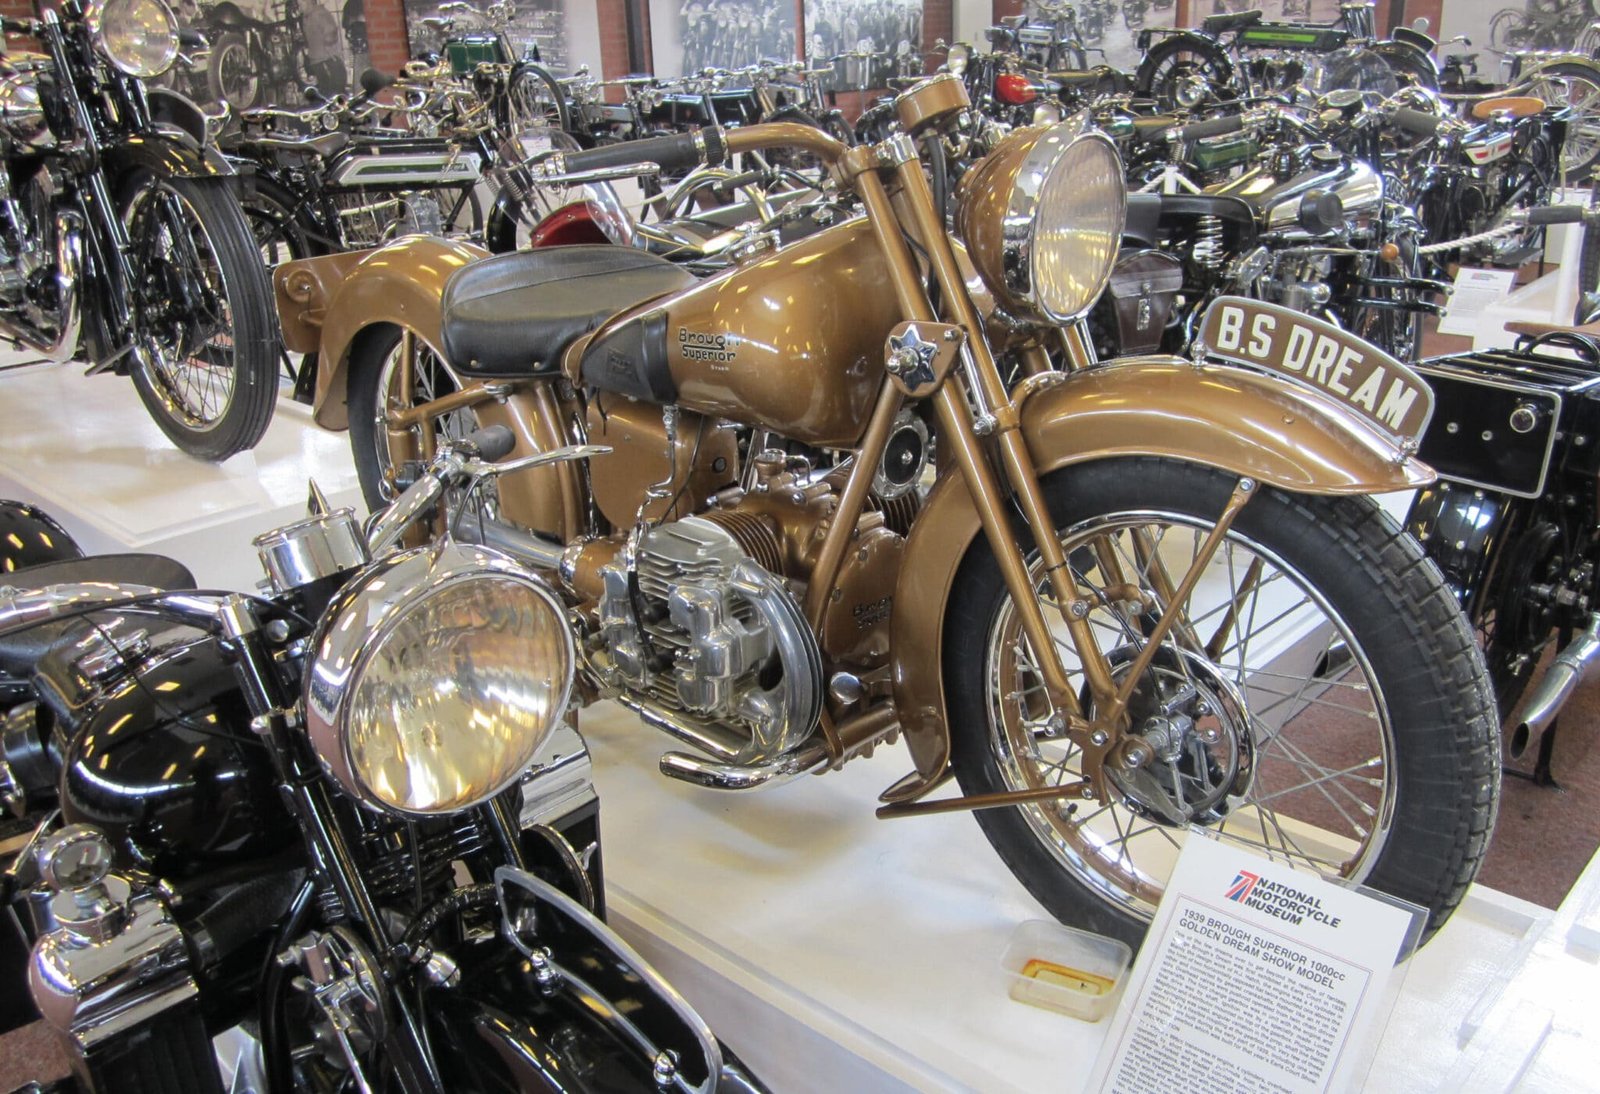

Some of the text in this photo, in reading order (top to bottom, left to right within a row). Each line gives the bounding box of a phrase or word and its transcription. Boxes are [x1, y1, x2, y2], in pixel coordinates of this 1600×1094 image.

[681, 345, 737, 362] Superior
[1217, 306, 1418, 430] B.S DREAM
[1244, 896, 1304, 926] MUSEUM
[1251, 886, 1342, 929] MOTORCYCLE
[1256, 876, 1322, 910] NATIONAL
[1178, 917, 1336, 989] GOLDEN DREAM SHOW MODEL
[1182, 908, 1346, 981] 1939 BROUGH SUPERIOR 1000cc
[1142, 1011, 1180, 1031] SPECIFICTION
